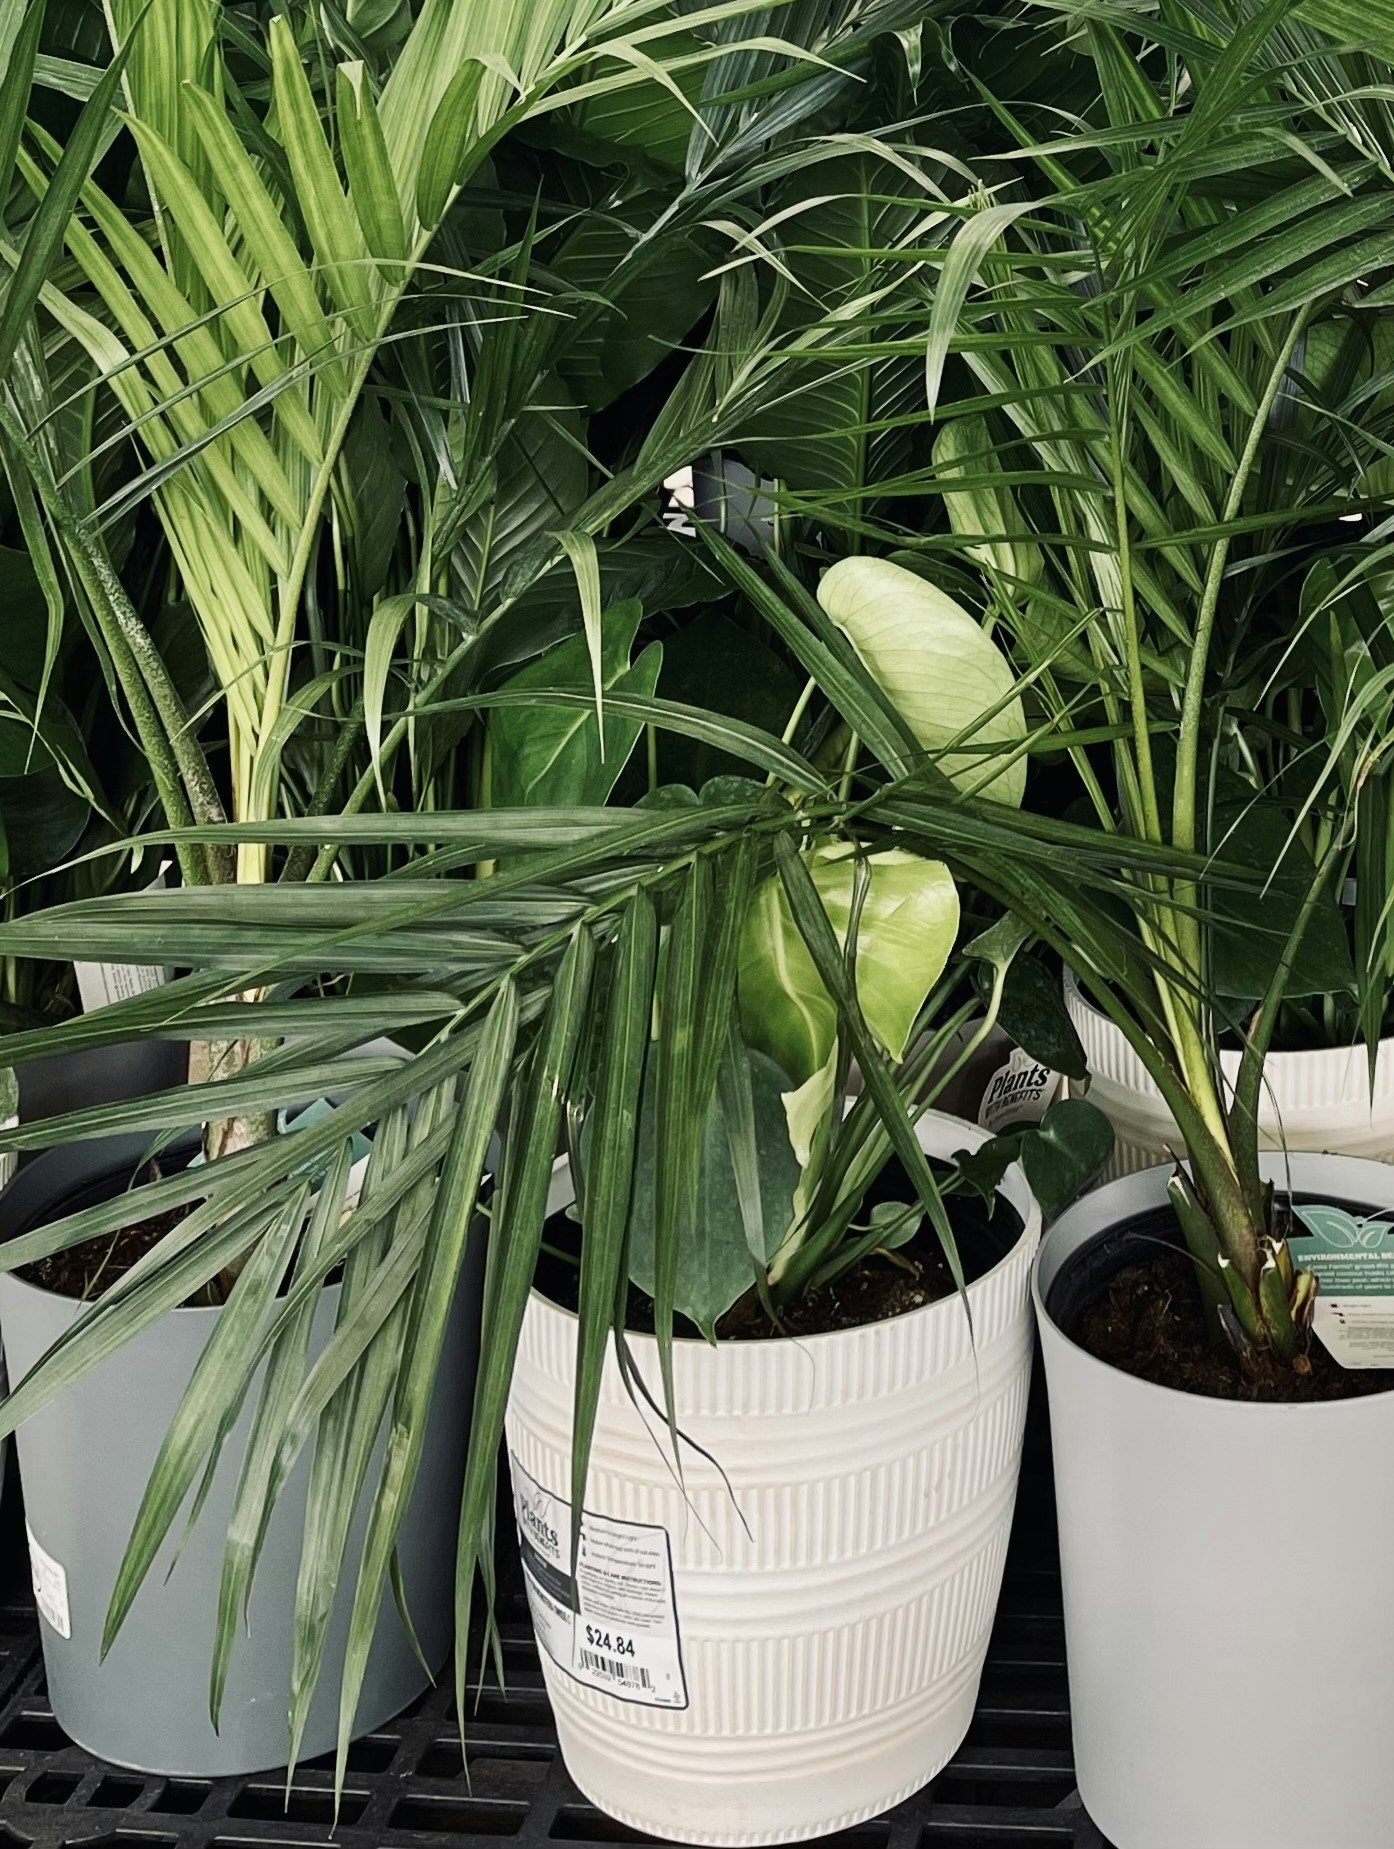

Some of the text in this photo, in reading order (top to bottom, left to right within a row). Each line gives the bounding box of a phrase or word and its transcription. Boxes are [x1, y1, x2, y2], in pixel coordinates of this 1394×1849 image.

[988, 1064, 1050, 1104] Plants
[1297, 1252, 1380, 1262] ENVIRONMENTAL
[520, 1493, 559, 1547] Plants
[585, 1624, 635, 1657] $24.84
